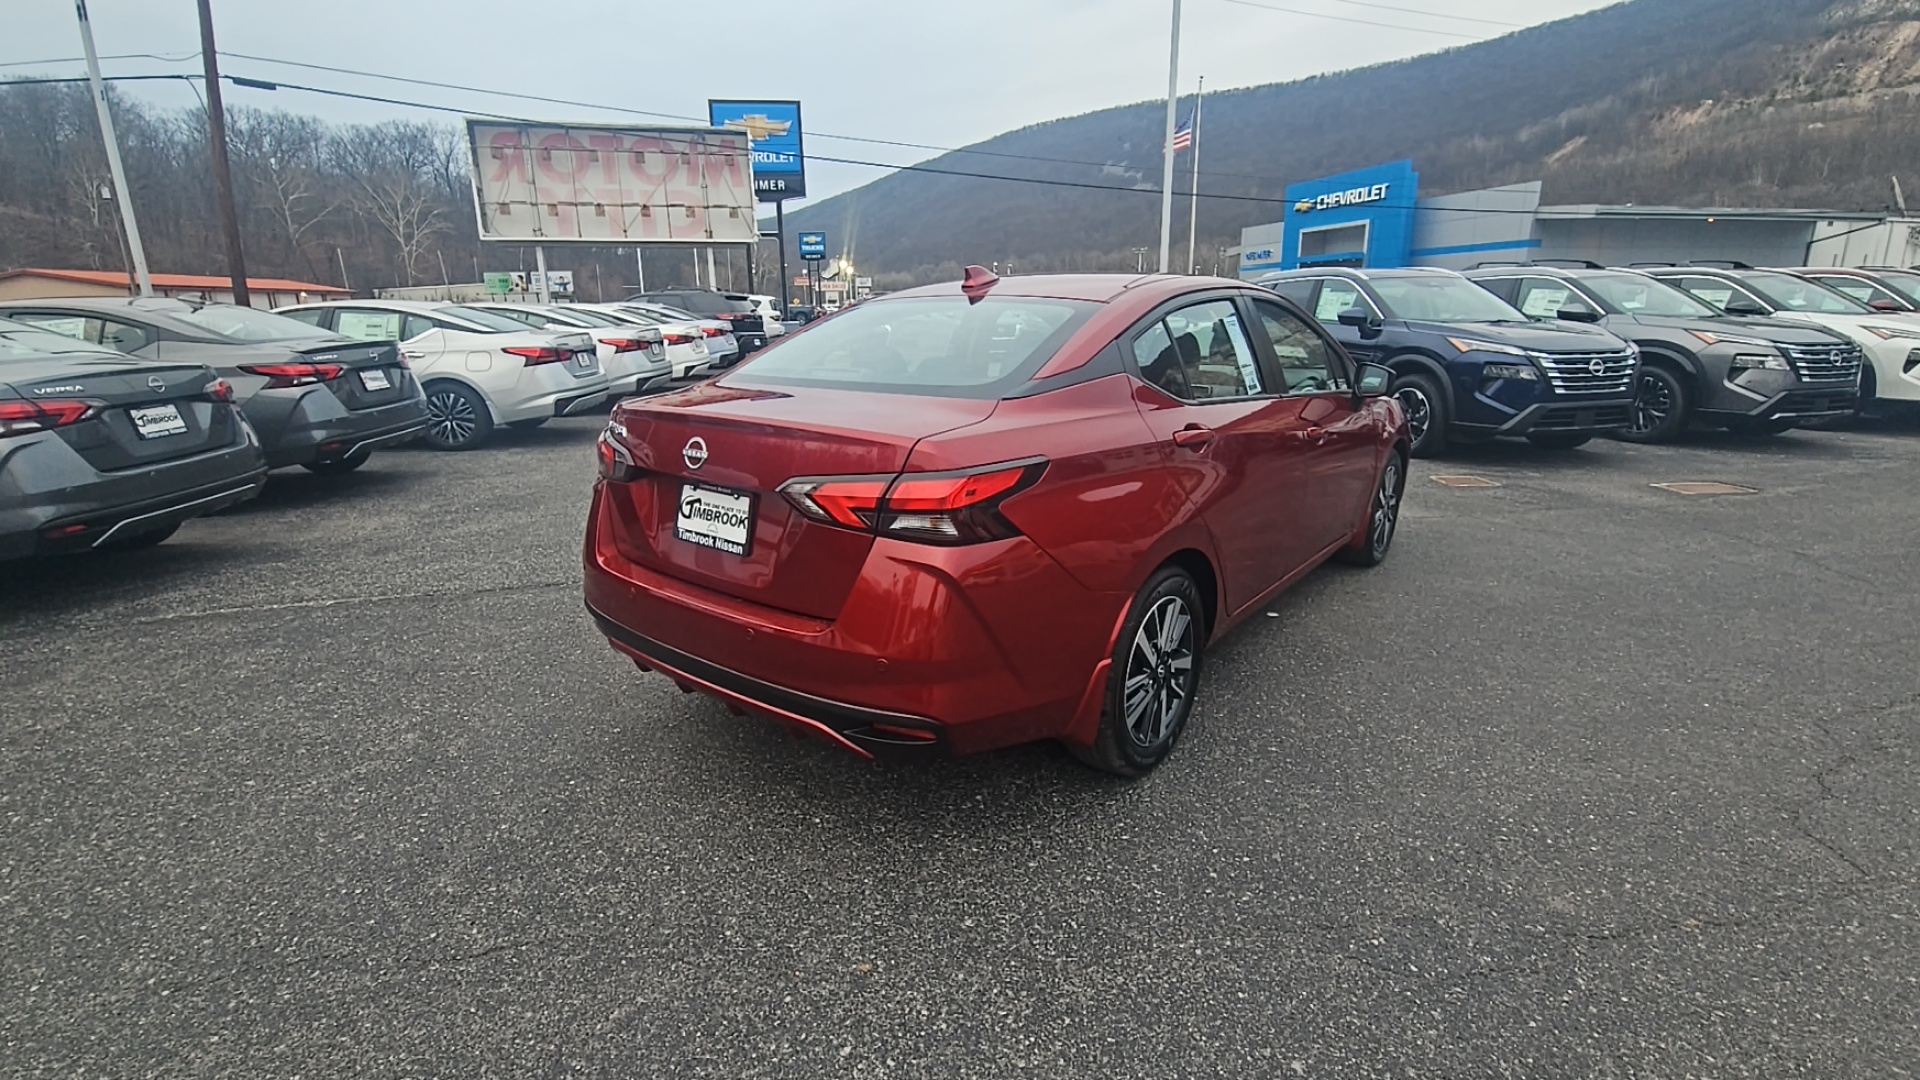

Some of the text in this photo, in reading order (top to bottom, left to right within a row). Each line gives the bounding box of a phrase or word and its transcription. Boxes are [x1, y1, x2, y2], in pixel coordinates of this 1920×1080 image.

[1316, 183, 1389, 210] CHEVROLET
[33, 385, 84, 395] VERSA
[678, 528, 743, 555] Timbrook Nissan
